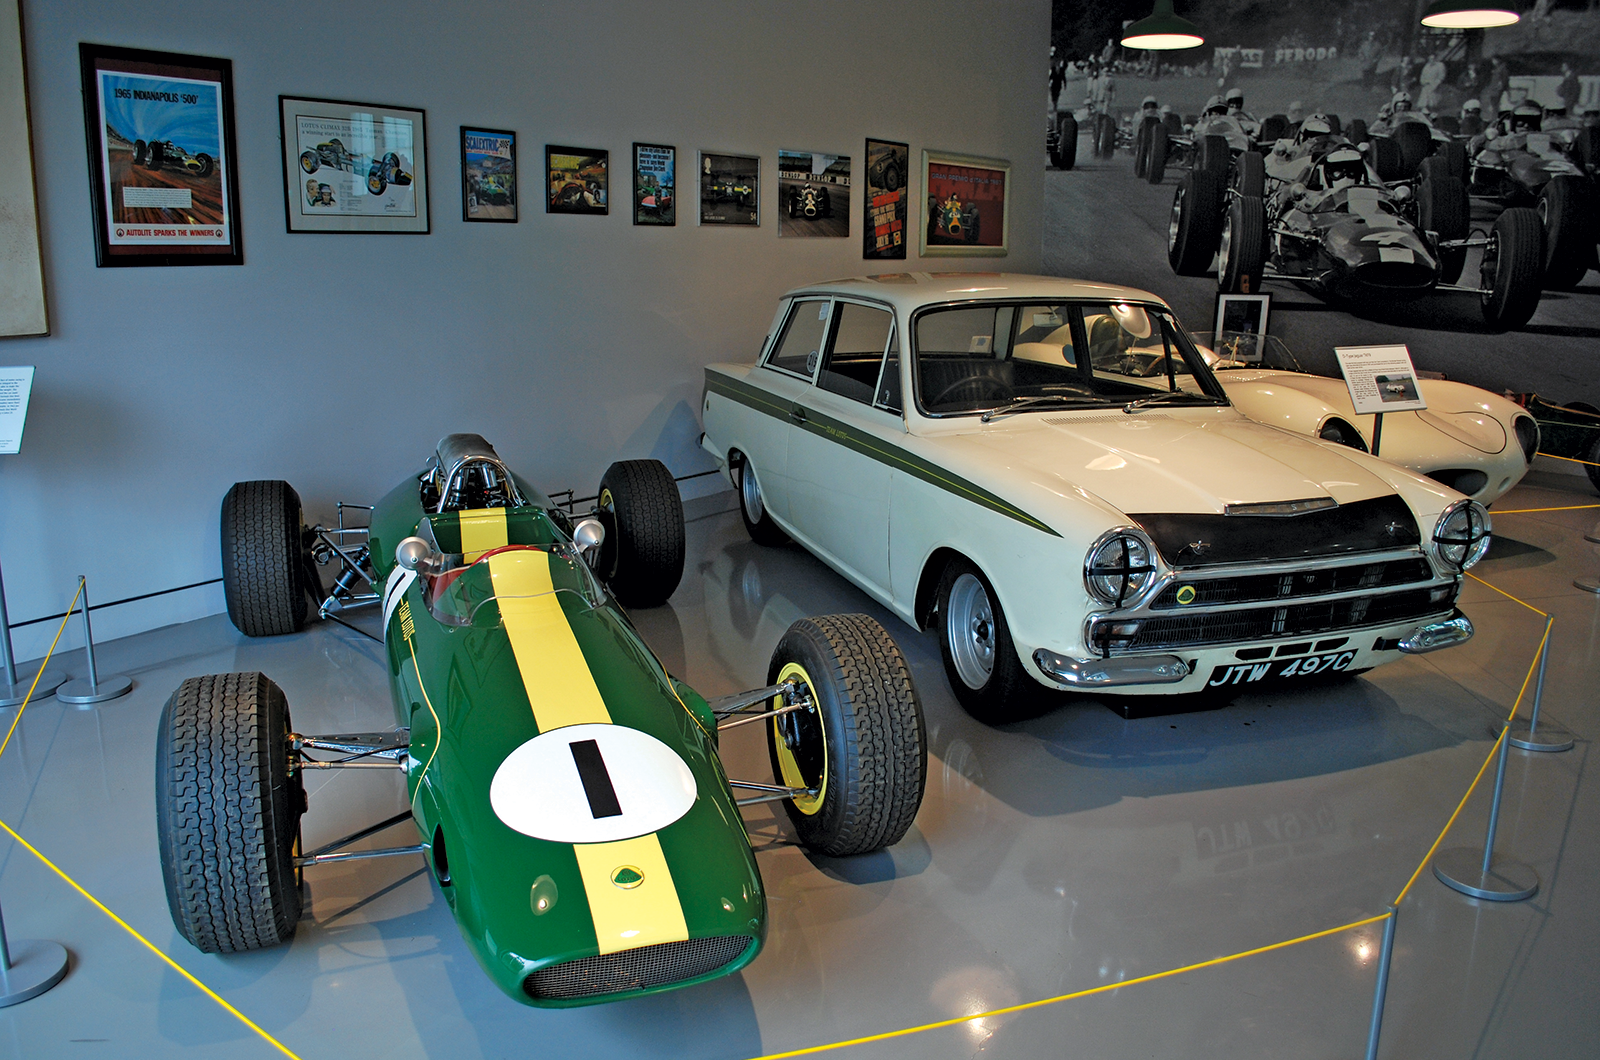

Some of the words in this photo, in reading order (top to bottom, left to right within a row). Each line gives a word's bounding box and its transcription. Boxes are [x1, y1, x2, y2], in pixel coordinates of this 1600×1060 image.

[114, 88, 131, 99] 1965
[133, 90, 179, 102] INDIANAPOLIS
[466, 136, 499, 151] SCALEXTRIC
[810, 173, 831, 183] DUNLOP
[948, 174, 969, 182] PREMIO
[126, 229, 152, 237] AUTOLITE
[153, 229, 176, 237] SPARKS
[178, 229, 187, 237] THE
[190, 229, 215, 237] WINNERS
[826, 425, 836, 435] TEAM
[836, 429, 848, 440] LOTUS
[398, 601, 411, 624] TEAM
[401, 617, 415, 641] LOTUS
[1209, 662, 1272, 687] JTW
[1280, 652, 1354, 678] 497C
[569, 739, 623, 819] 1
